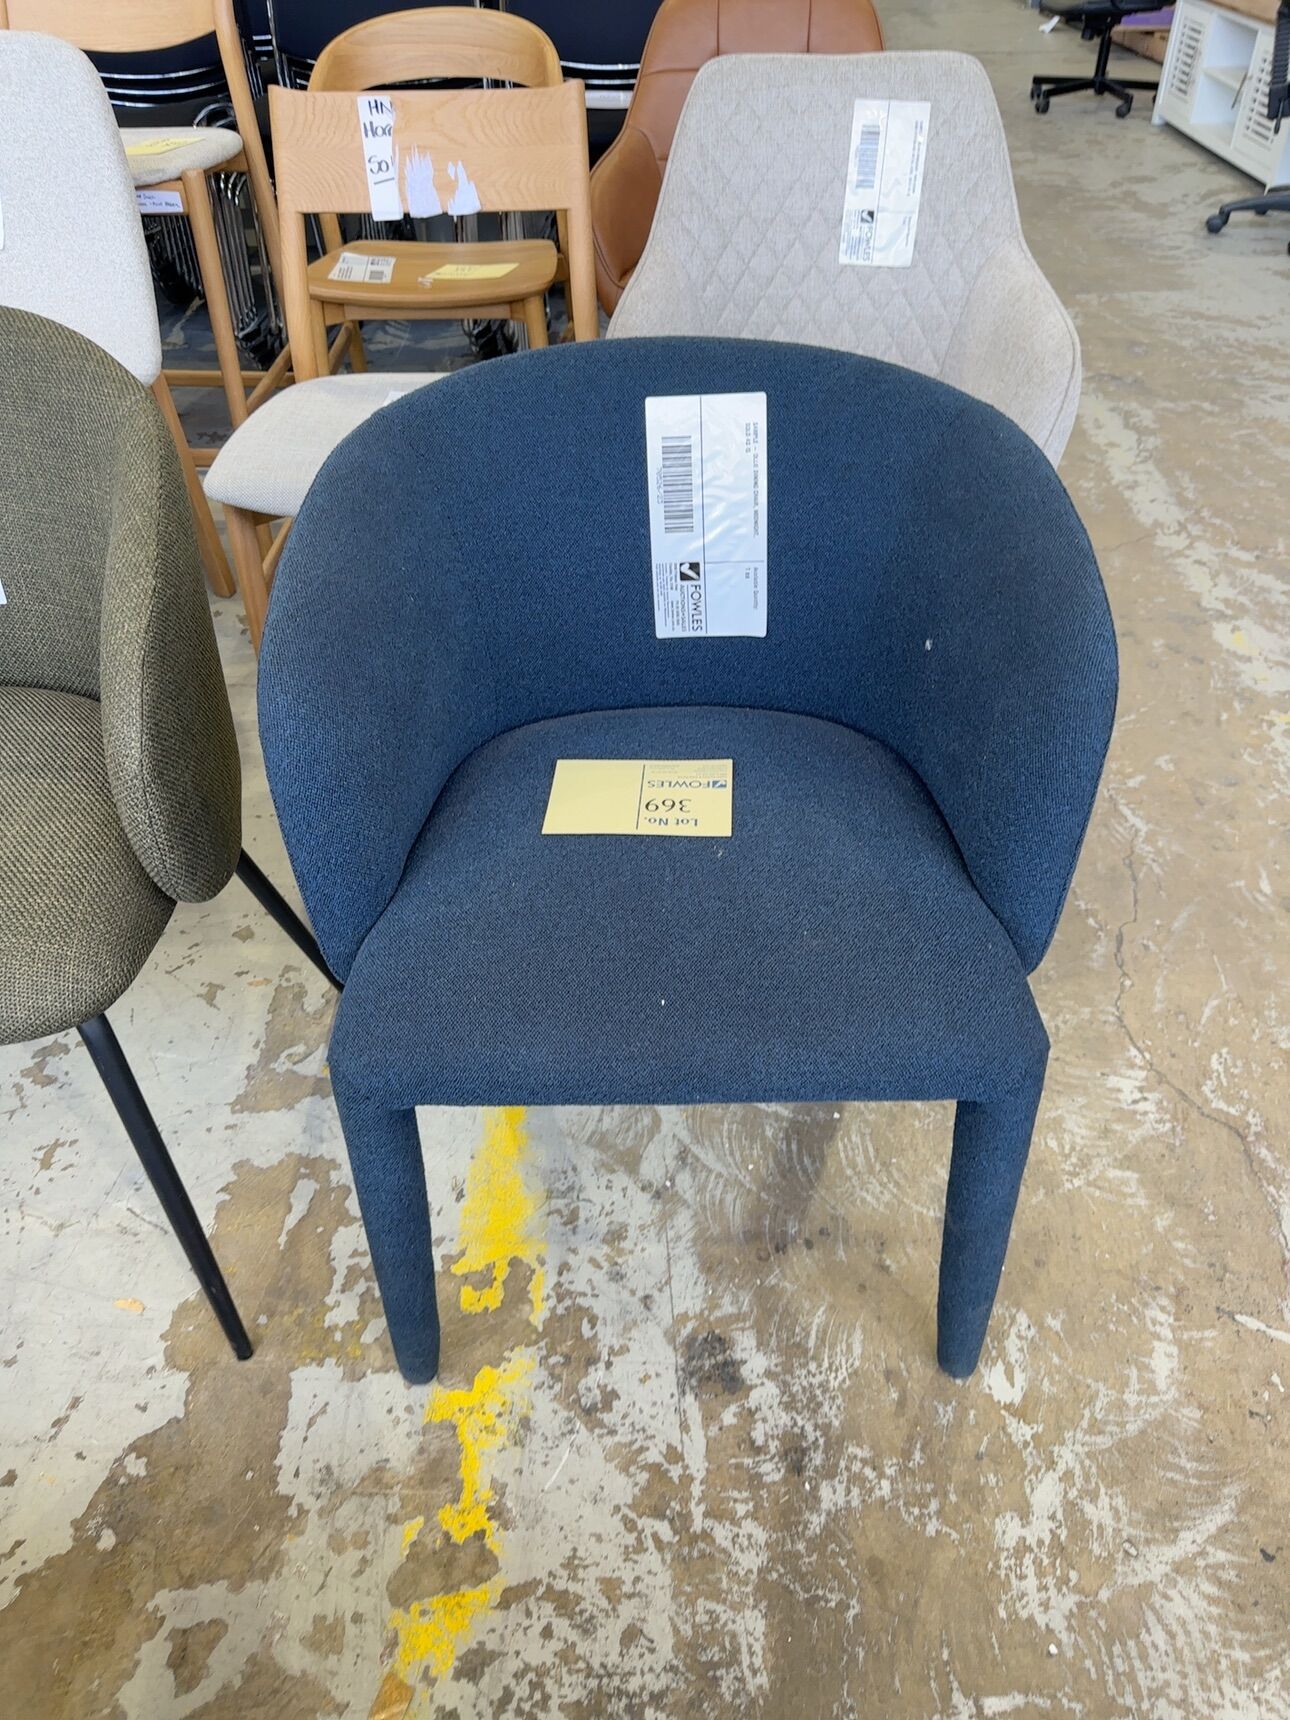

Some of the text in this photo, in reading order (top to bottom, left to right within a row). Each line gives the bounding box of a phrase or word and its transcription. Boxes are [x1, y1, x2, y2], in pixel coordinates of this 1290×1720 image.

[690, 584, 703, 632] FOWLES
[647, 779, 712, 789] FOWLES
[644, 798, 692, 813] 369
[644, 817, 698, 827] Lot No.
